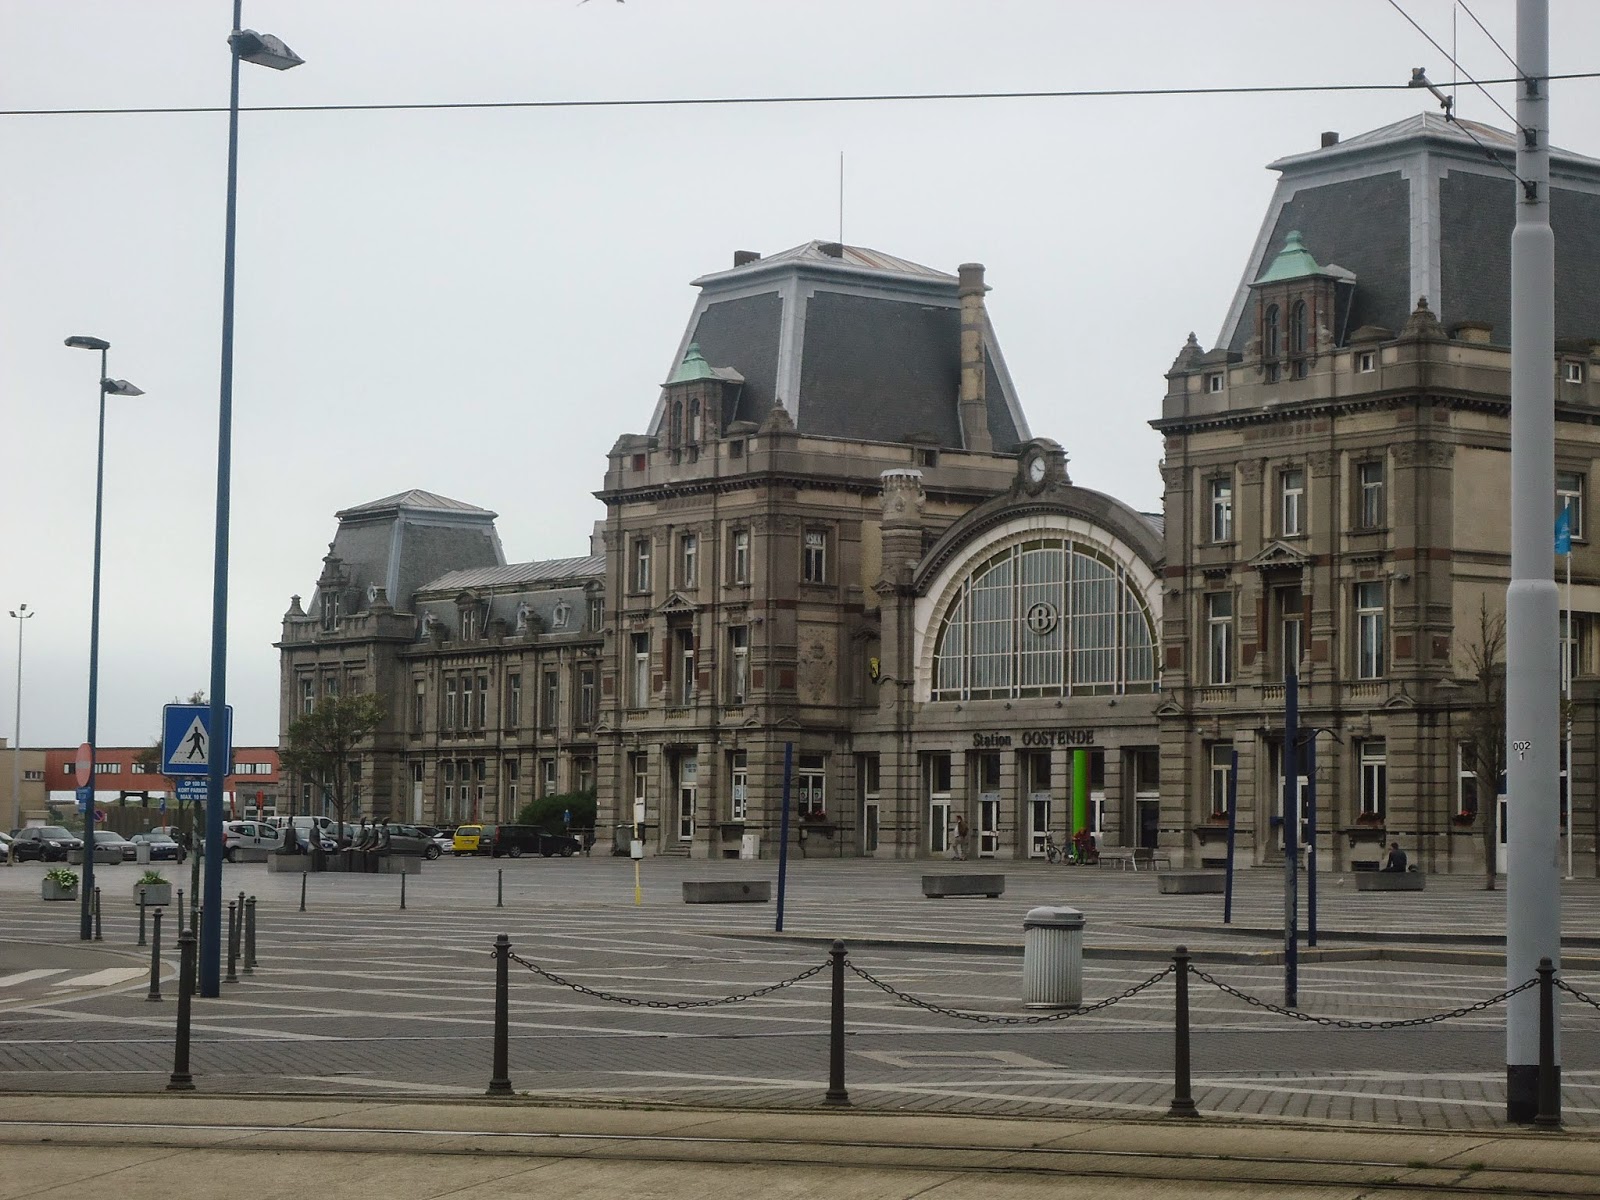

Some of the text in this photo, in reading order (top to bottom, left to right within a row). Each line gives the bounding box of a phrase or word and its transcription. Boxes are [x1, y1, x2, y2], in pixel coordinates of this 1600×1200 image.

[973, 730, 1095, 747] Station OOSTENDE
[1513, 741, 1531, 751] 002
